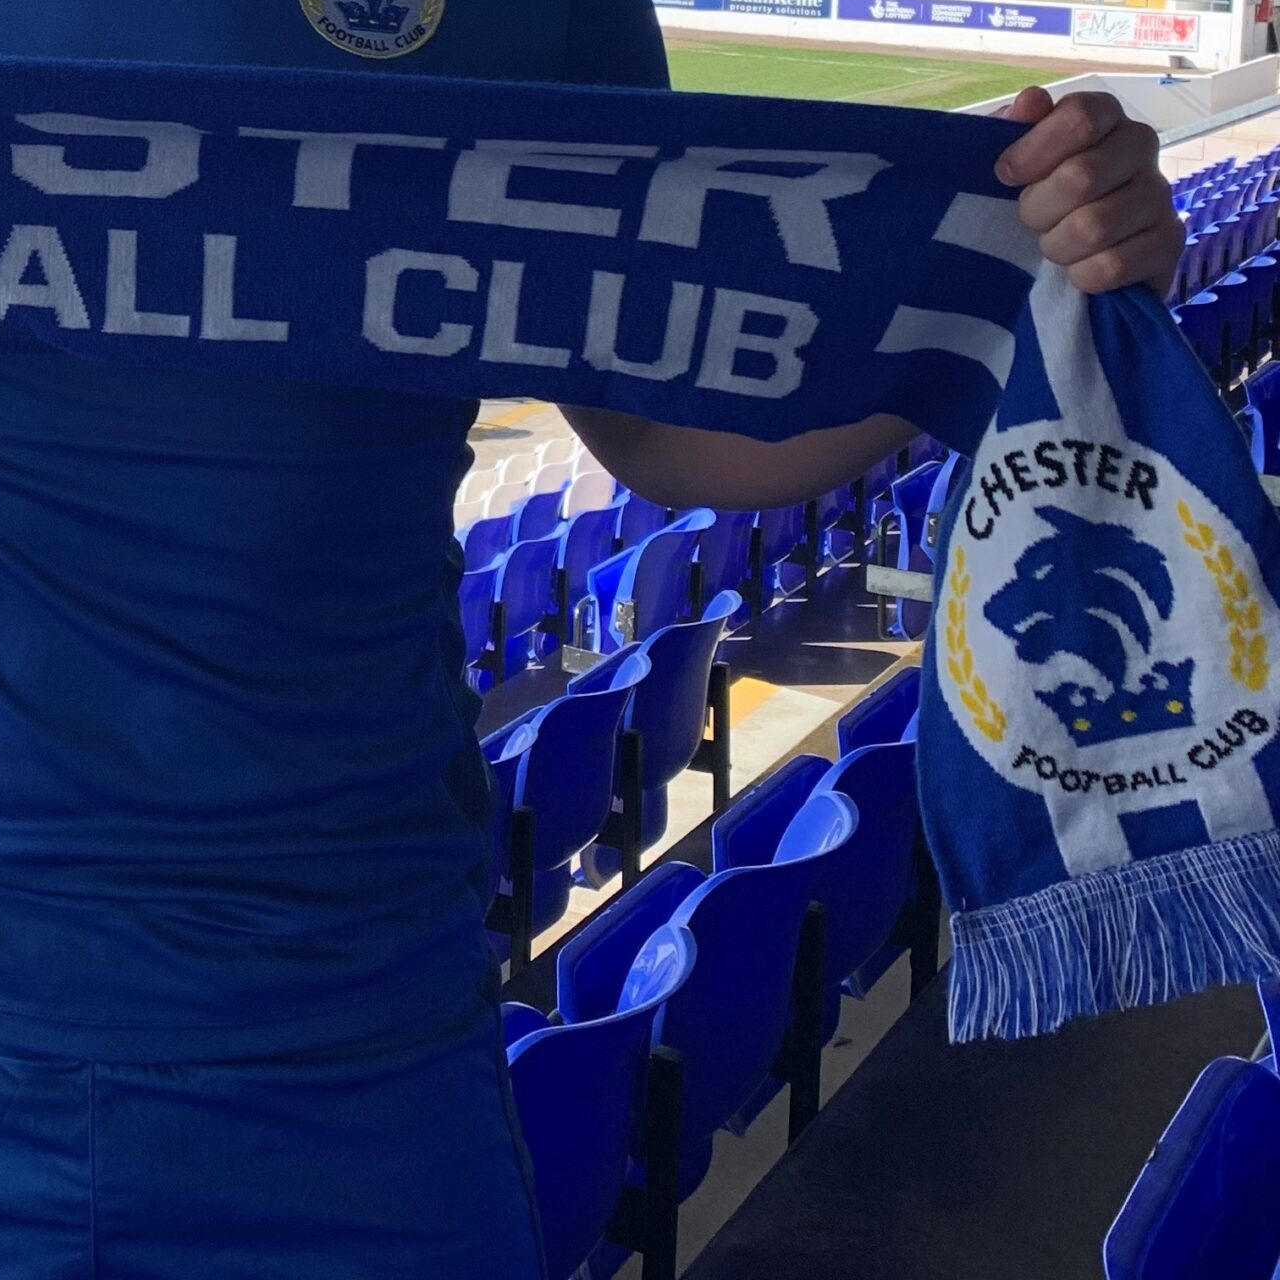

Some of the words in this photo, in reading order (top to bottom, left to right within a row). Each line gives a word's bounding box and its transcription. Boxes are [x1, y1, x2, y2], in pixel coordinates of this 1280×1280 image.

[318, 16, 389, 52] FOOTBALL
[395, 23, 427, 48] CLUB
[730, 3, 773, 15] property
[775, 5, 822, 17] solutions
[363, 247, 820, 399] CLUB
[964, 438, 1160, 540] CHESTER
[1012, 744, 1188, 795] FOOTBALL
[1187, 708, 1270, 769] CLUB
